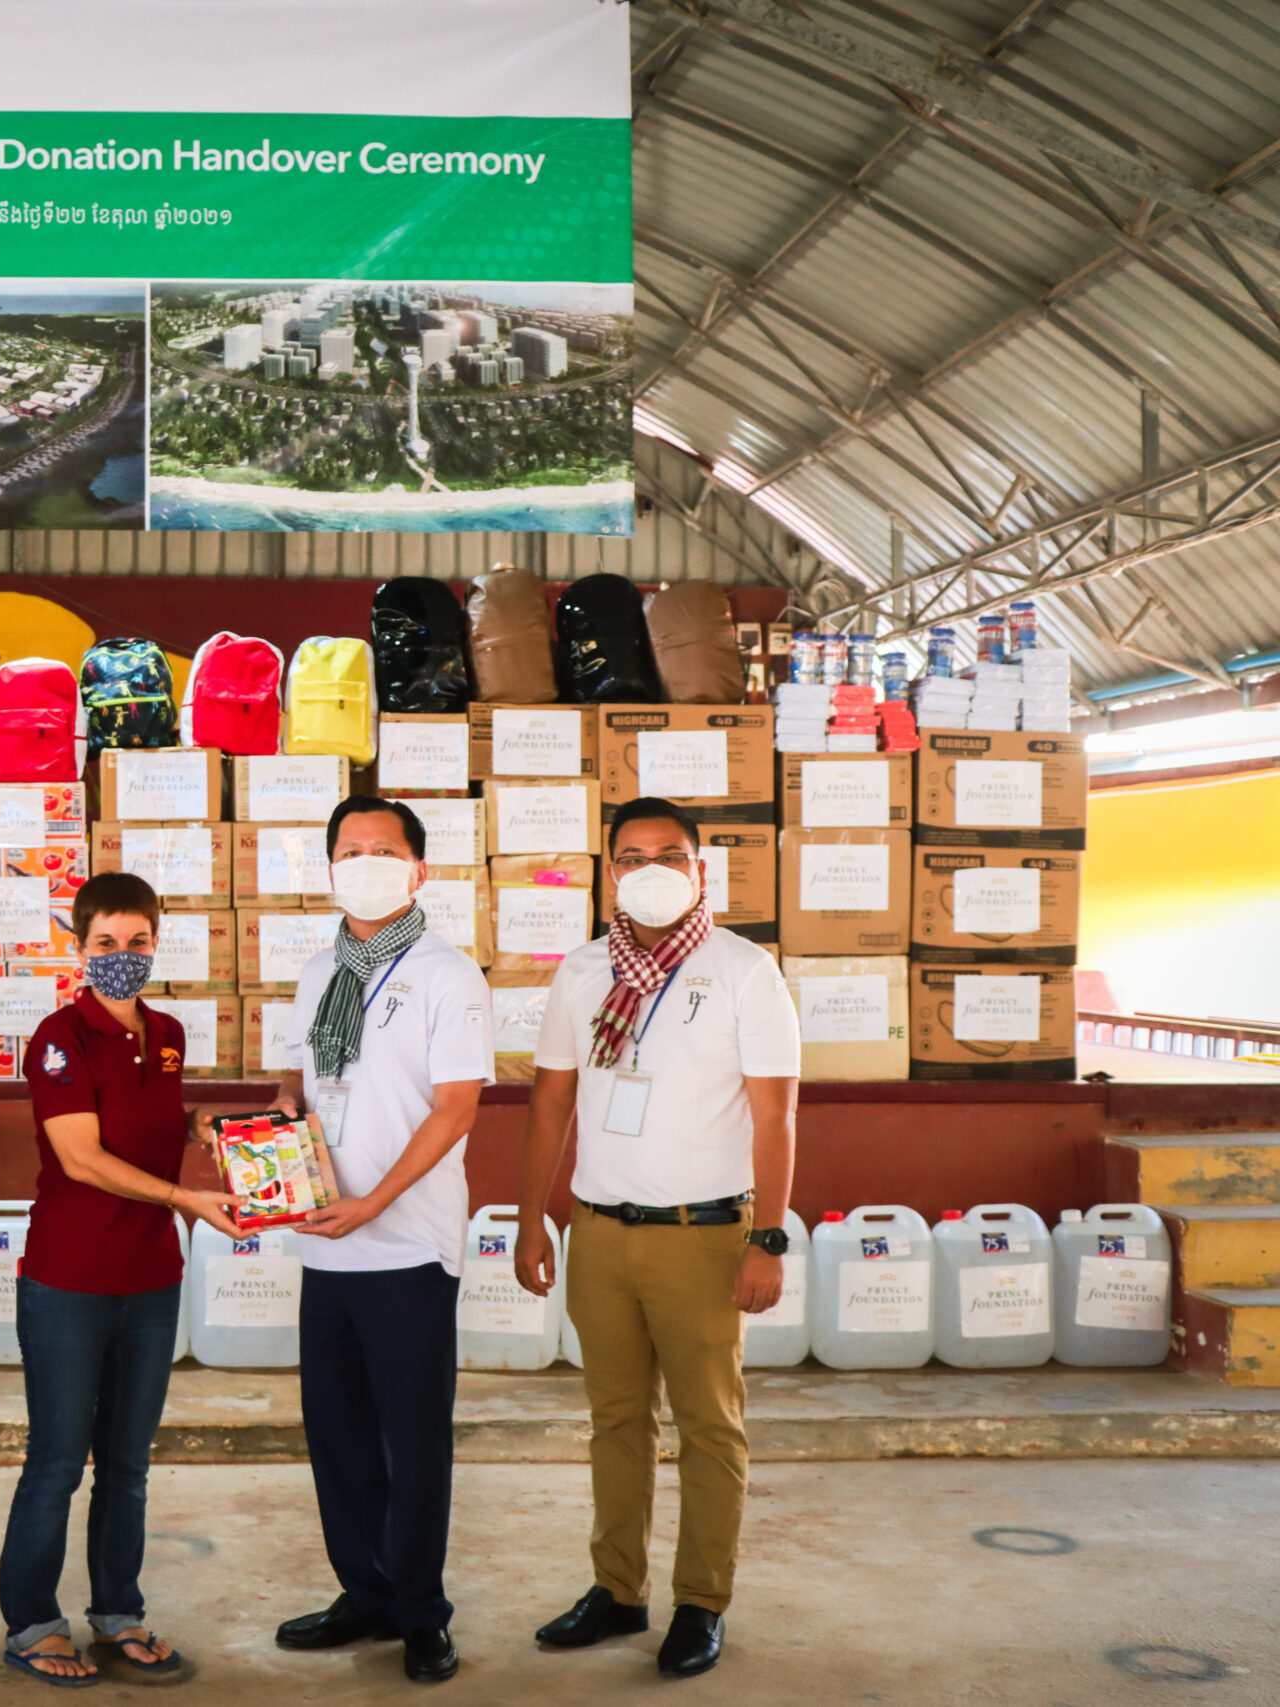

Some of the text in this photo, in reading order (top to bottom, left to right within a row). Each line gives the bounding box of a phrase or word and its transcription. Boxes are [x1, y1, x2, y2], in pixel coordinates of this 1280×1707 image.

[173, 138, 352, 173] Handover
[359, 142, 546, 184] Ceremony
[524, 911, 565, 919] PRINCE
[233, 1280, 277, 1288] PRINCE
[1107, 1283, 1148, 1292] PRINCE
[480, 1285, 523, 1294] PRINCE
[867, 1286, 909, 1294] PRINCE
[988, 1289, 1029, 1299] PRINCE
